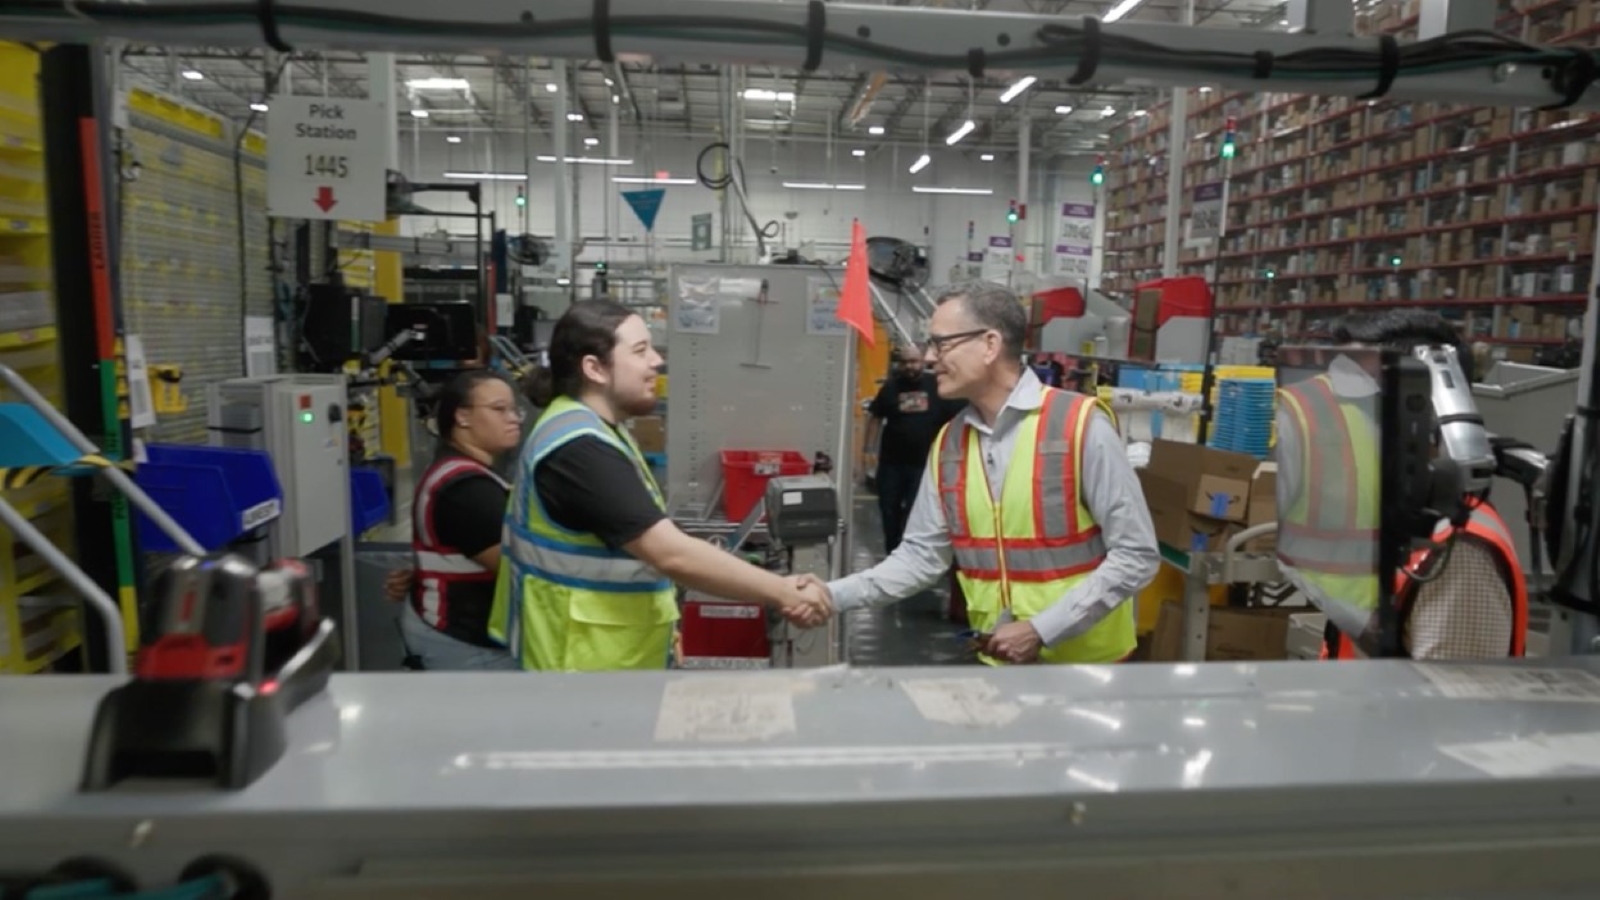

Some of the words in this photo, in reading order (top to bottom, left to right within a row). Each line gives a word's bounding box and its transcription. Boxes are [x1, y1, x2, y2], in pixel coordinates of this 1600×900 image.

[309, 103, 345, 119] Pick
[295, 122, 357, 140] Station
[305, 154, 348, 178] 1445
